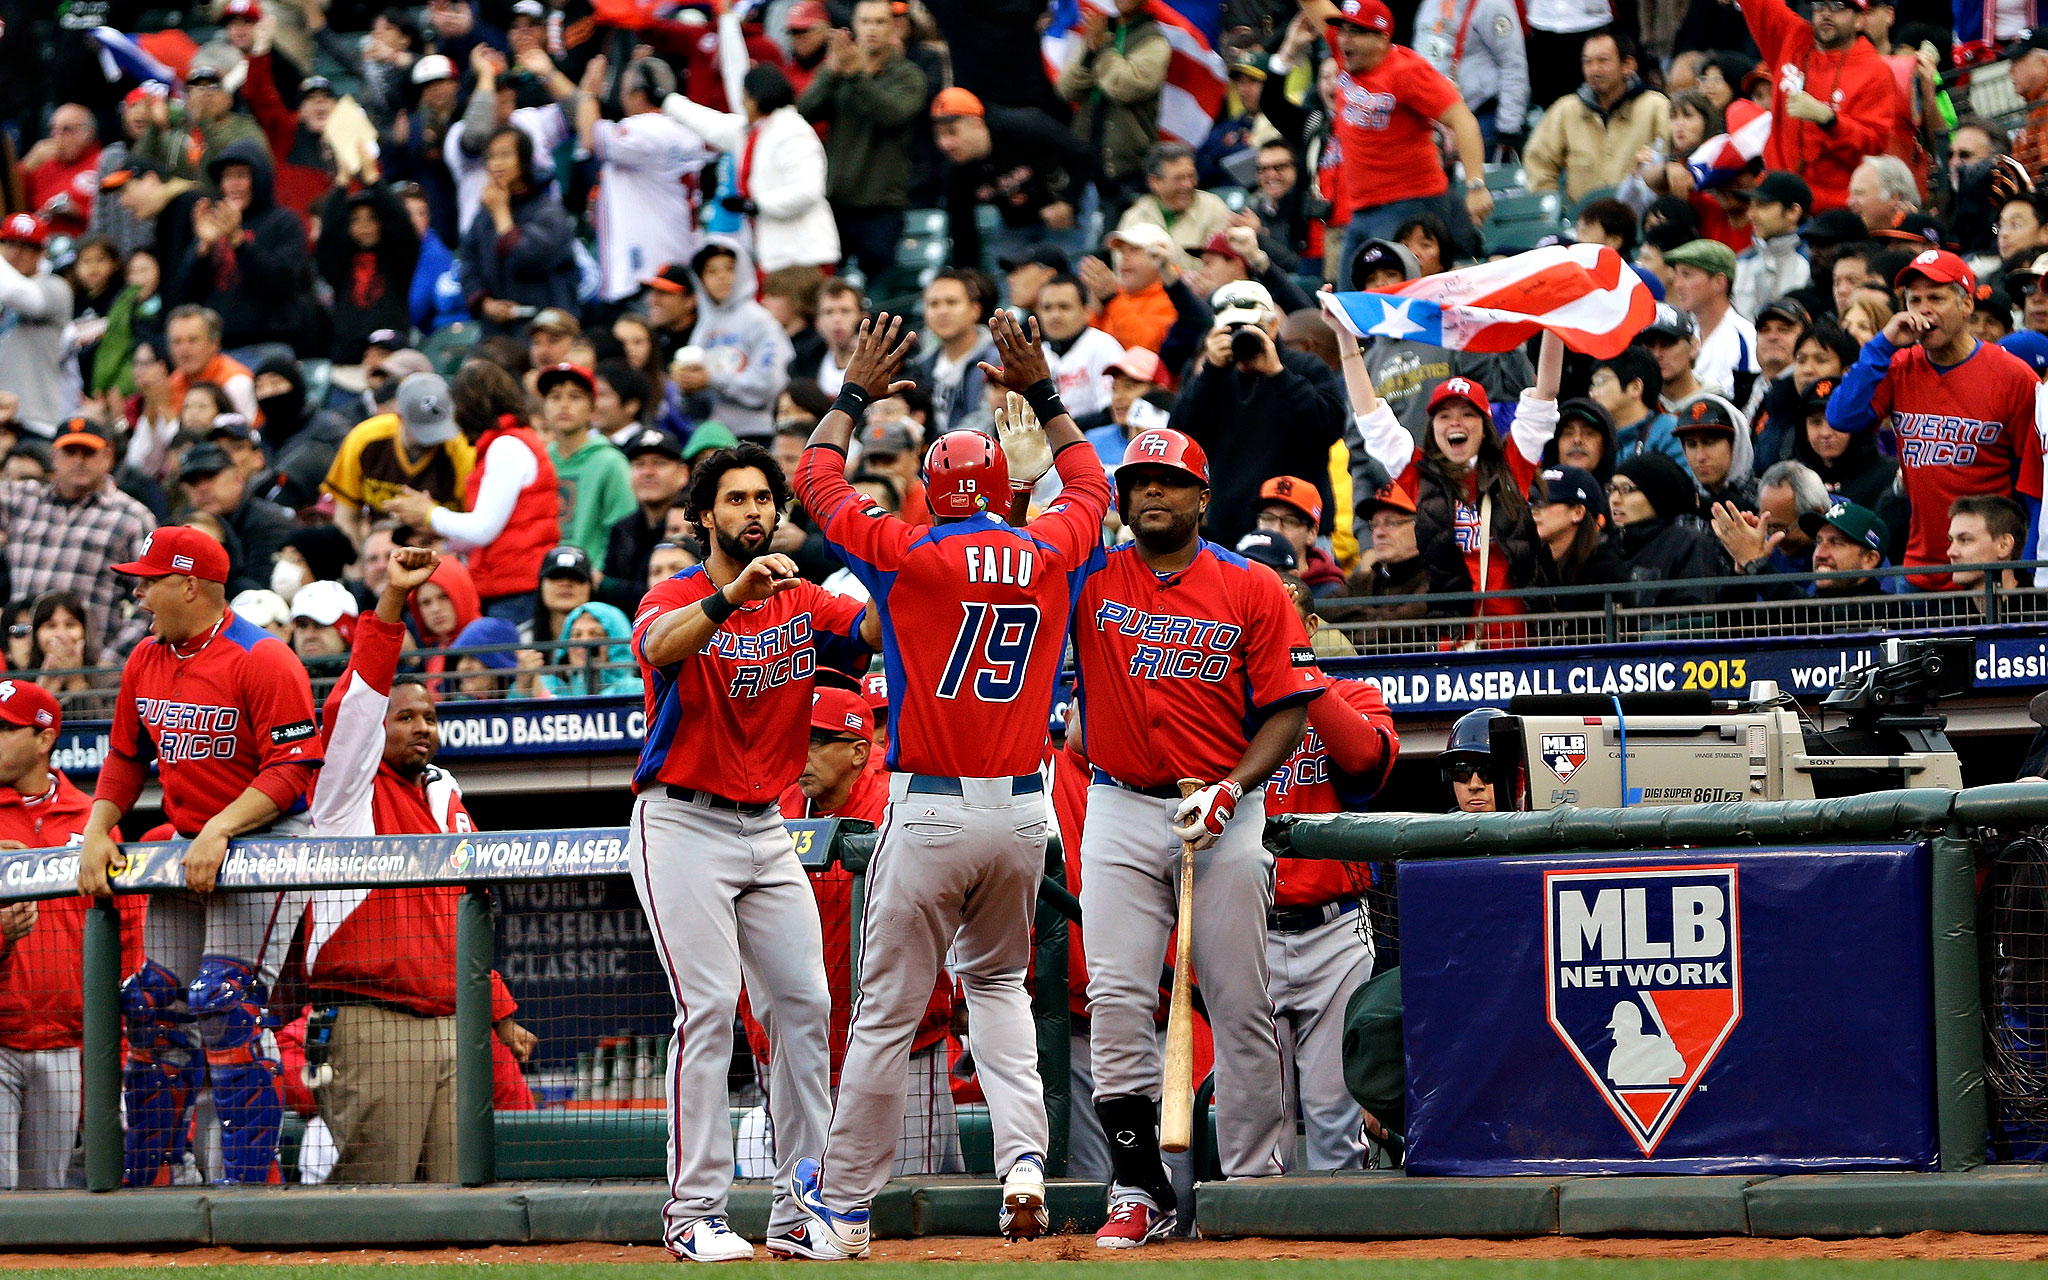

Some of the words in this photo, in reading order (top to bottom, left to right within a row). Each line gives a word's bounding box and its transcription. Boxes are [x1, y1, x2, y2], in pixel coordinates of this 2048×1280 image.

[1891, 411, 2003, 445] PUERTO
[1139, 434, 1168, 457] PR
[1903, 439, 1977, 468] RICO
[958, 479, 976, 493] 19
[965, 546, 1033, 588] FALU
[698, 611, 813, 660] PUERTO
[1096, 598, 1242, 652] PUERTO
[935, 600, 1041, 703] 19
[1129, 643, 1231, 682] RICO
[728, 647, 816, 698] RICO
[1358, 675, 1430, 705] ORLD
[1436, 668, 1562, 701] BASEBALL
[1568, 662, 1676, 694] CLASSIC
[1682, 659, 1748, 691] 2013
[135, 697, 240, 732] PUERTO
[512, 712, 625, 744] BASEBALL
[160, 730, 237, 763] RICO
[1542, 736, 1585, 750] MLB
[1608, 751, 1636, 759] Caon
[1551, 789, 1580, 803] HD
[1644, 787, 1662, 799] DIGI
[1664, 787, 1692, 799] SUPER
[476, 841, 550, 868] WORLD
[552, 838, 631, 865] BASEBA
[7, 856, 81, 886] CLASSI
[505, 911, 651, 945] BASEBALL
[1558, 885, 1727, 962] MLB
[505, 948, 627, 982] CLASSIC
[1560, 962, 1728, 989] NETWORK
[1015, 1165, 1033, 1174] FALU
[850, 1227, 867, 1236] FALU
